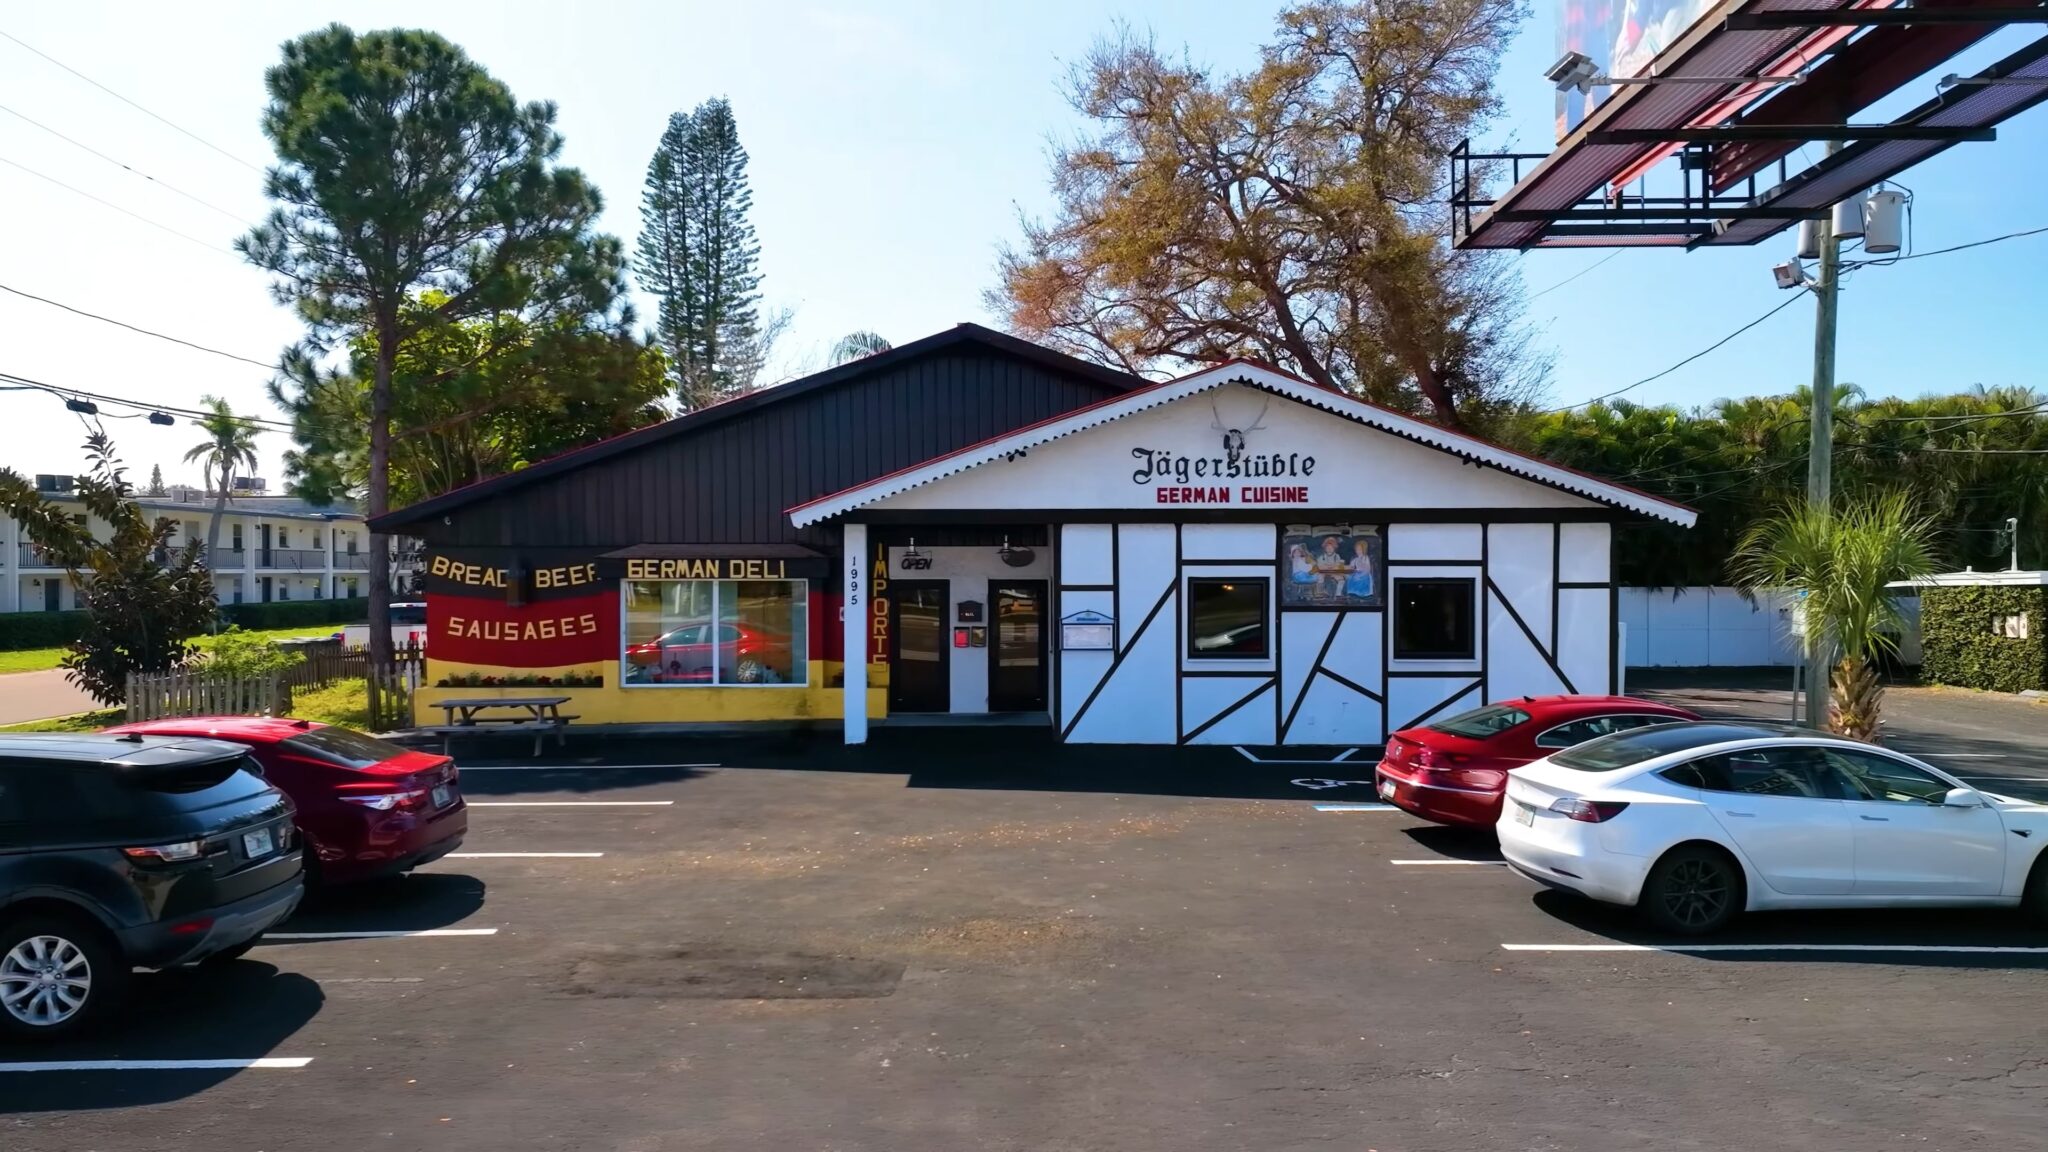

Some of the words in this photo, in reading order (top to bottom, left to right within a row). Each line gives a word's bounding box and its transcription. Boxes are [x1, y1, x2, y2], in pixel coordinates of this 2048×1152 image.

[1132, 447, 1316, 484] Jägerstüble
[1157, 487, 1230, 503] GERMAN
[1241, 487, 1309, 503] CUISINE
[627, 559, 719, 578] GERMAN
[729, 560, 785, 579] DELI
[901, 558, 933, 570] OPEN
[850, 556, 858, 605] 1995
[872, 542, 888, 672] IMPORTS
[447, 613, 597, 641] SAUSAGES
